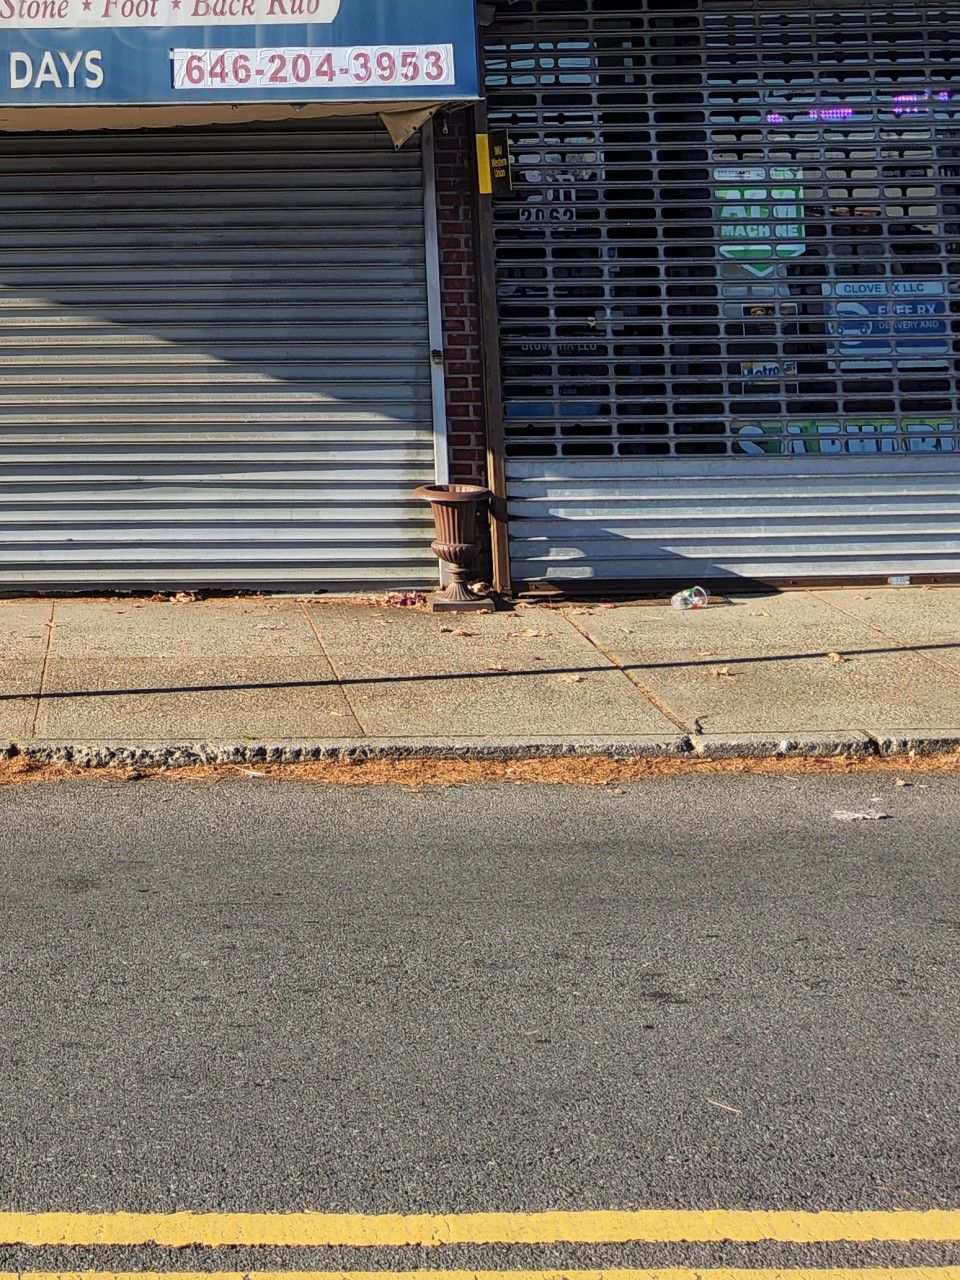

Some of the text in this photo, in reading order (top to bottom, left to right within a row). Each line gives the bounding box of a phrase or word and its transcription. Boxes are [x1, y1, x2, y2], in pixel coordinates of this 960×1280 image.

[10, 50, 105, 90] DAYS
[185, 49, 444, 86] 646-204-3953
[720, 223, 799, 238] MACHNE
[843, 284, 882, 294] CLOVE
[903, 283, 924, 293] LLC
[878, 321, 918, 329] DEIVERY
